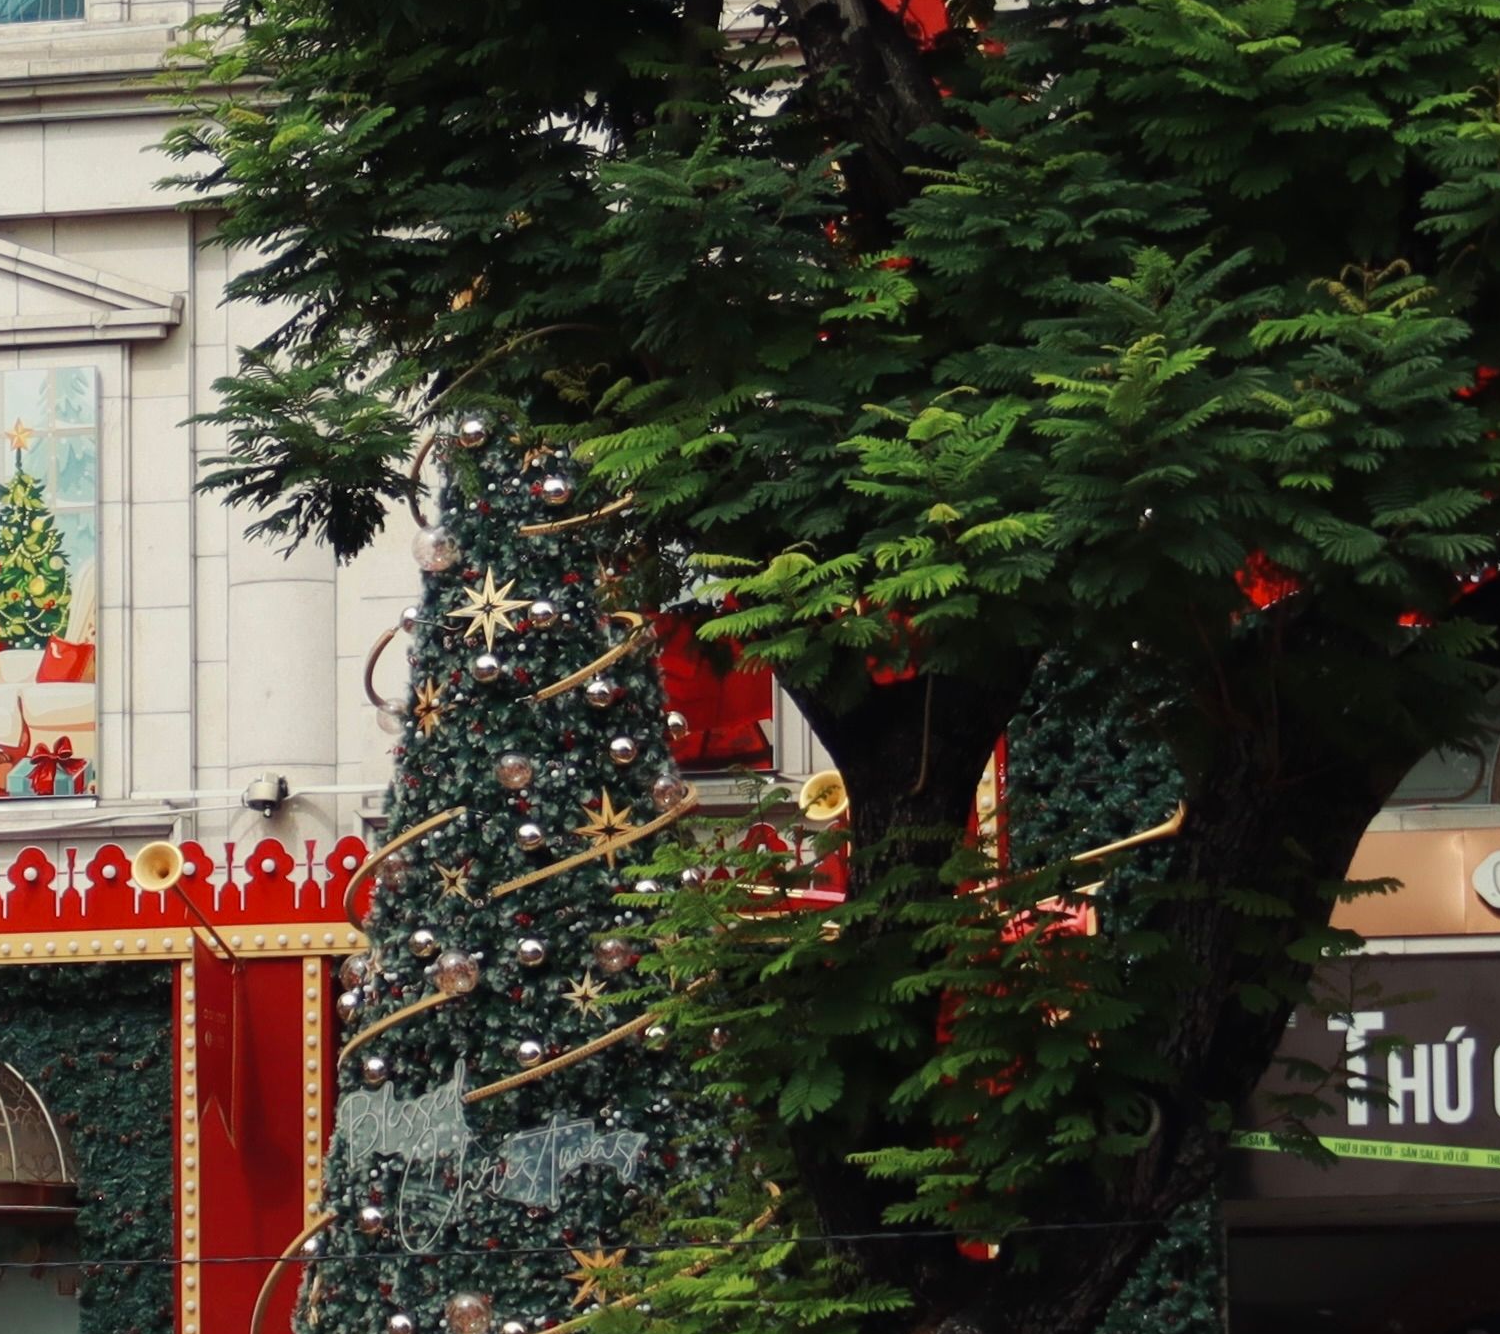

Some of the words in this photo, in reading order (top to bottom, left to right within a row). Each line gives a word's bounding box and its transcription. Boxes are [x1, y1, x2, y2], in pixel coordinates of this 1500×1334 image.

[339, 1058, 467, 1168] Blessed
[1327, 1011, 1476, 1126] THỨ
[399, 1114, 643, 1253] Christmas
[1419, 1148, 1441, 1161] SALE
